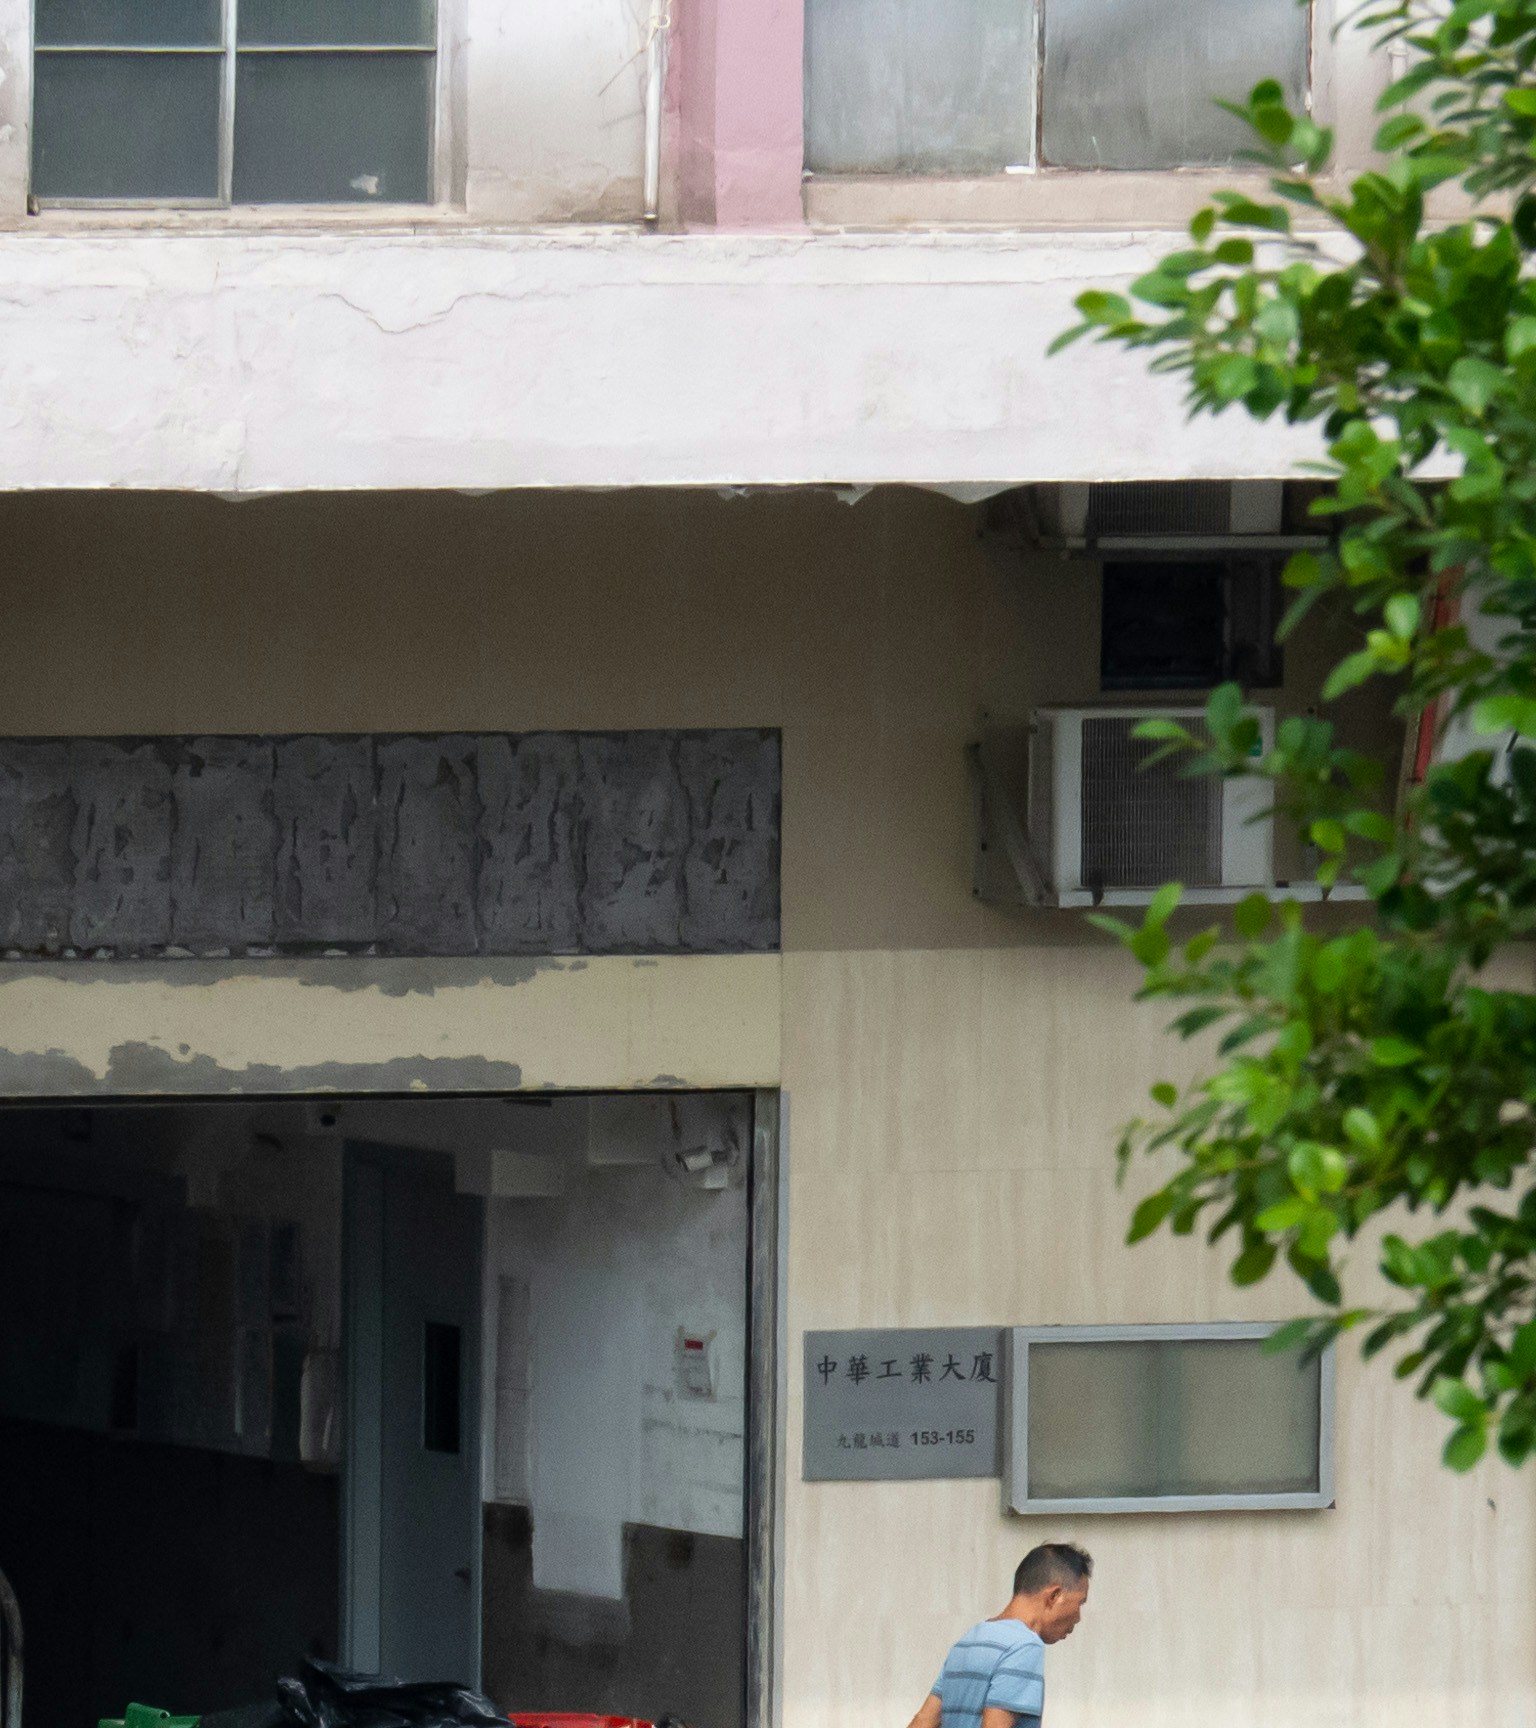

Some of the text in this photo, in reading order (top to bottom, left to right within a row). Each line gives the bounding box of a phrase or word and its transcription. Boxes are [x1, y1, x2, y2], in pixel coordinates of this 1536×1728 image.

[816, 1351, 998, 1386] 中華工業大廈
[910, 1429, 975, 1446] 153-155
